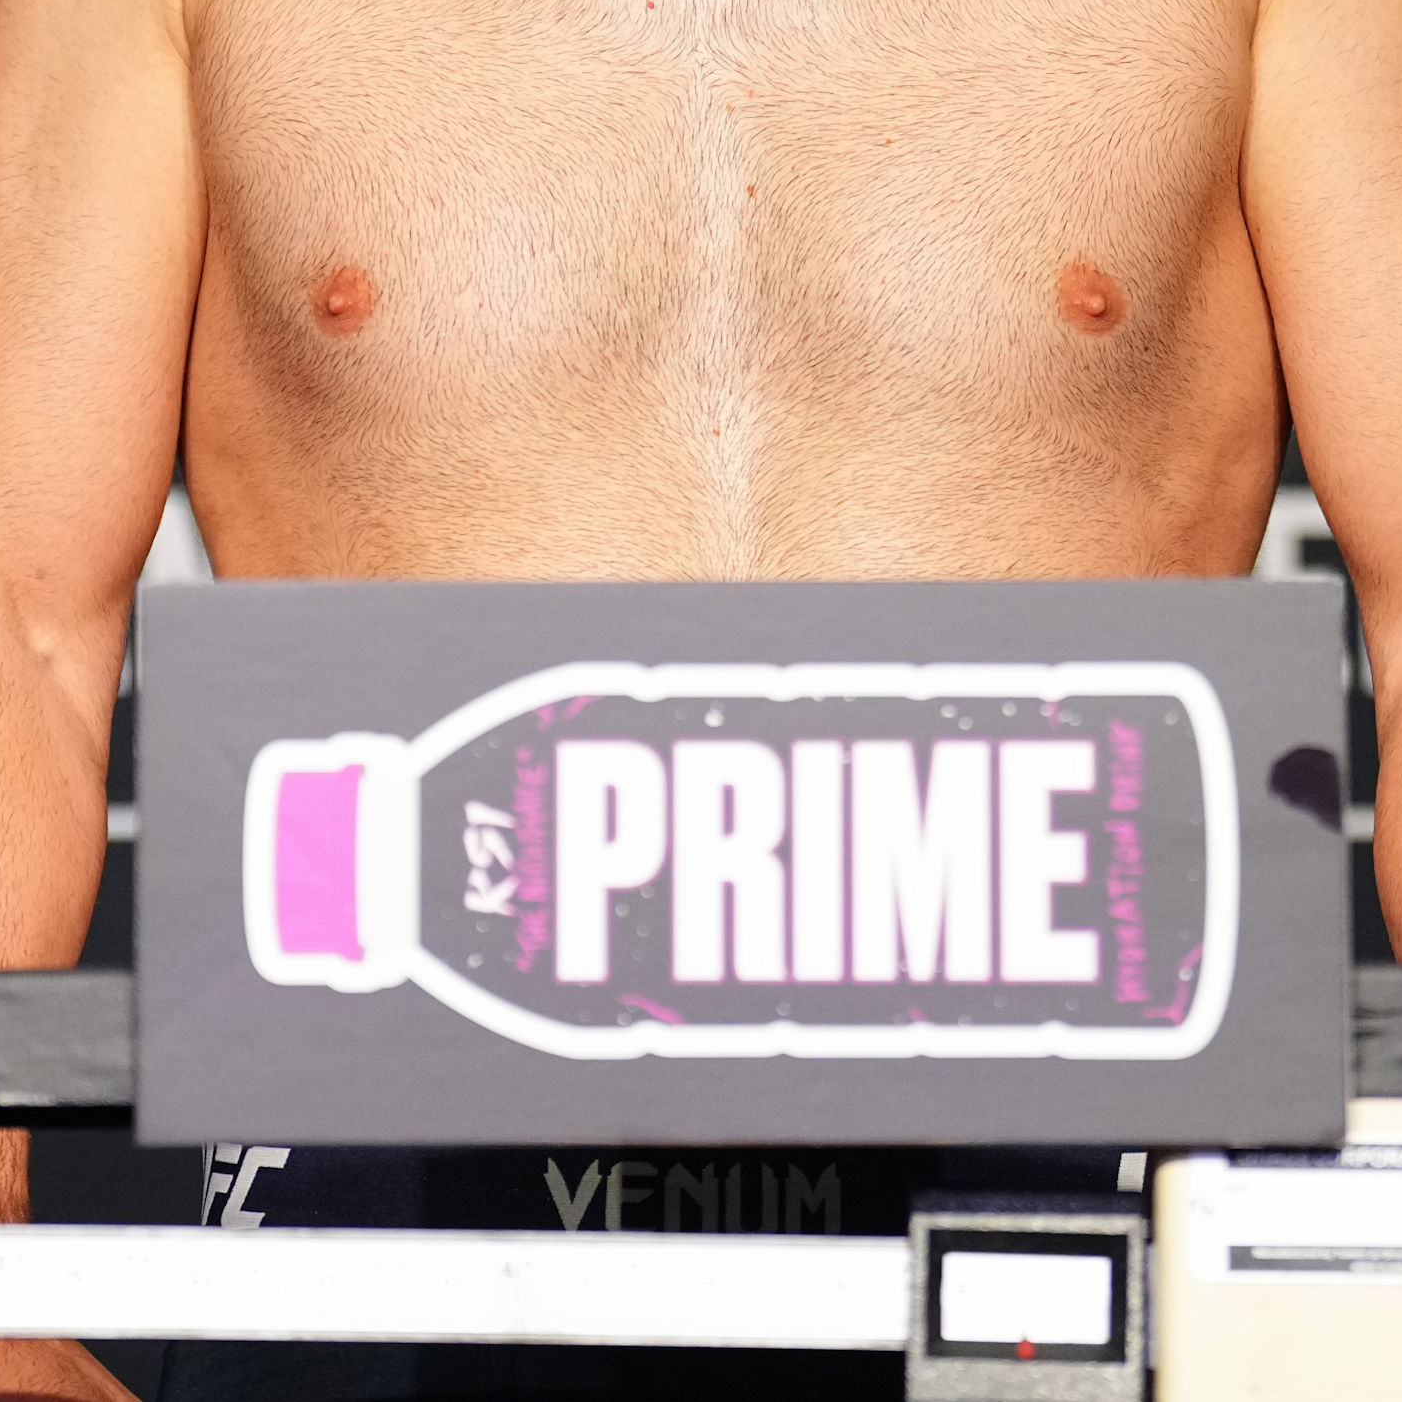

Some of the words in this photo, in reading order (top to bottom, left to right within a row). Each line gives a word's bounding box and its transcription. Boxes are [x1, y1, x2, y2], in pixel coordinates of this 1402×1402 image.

[463, 799, 519, 917] KSI
[554, 738, 1099, 984] PRIME
[543, 1156, 842, 1234] VENUM
